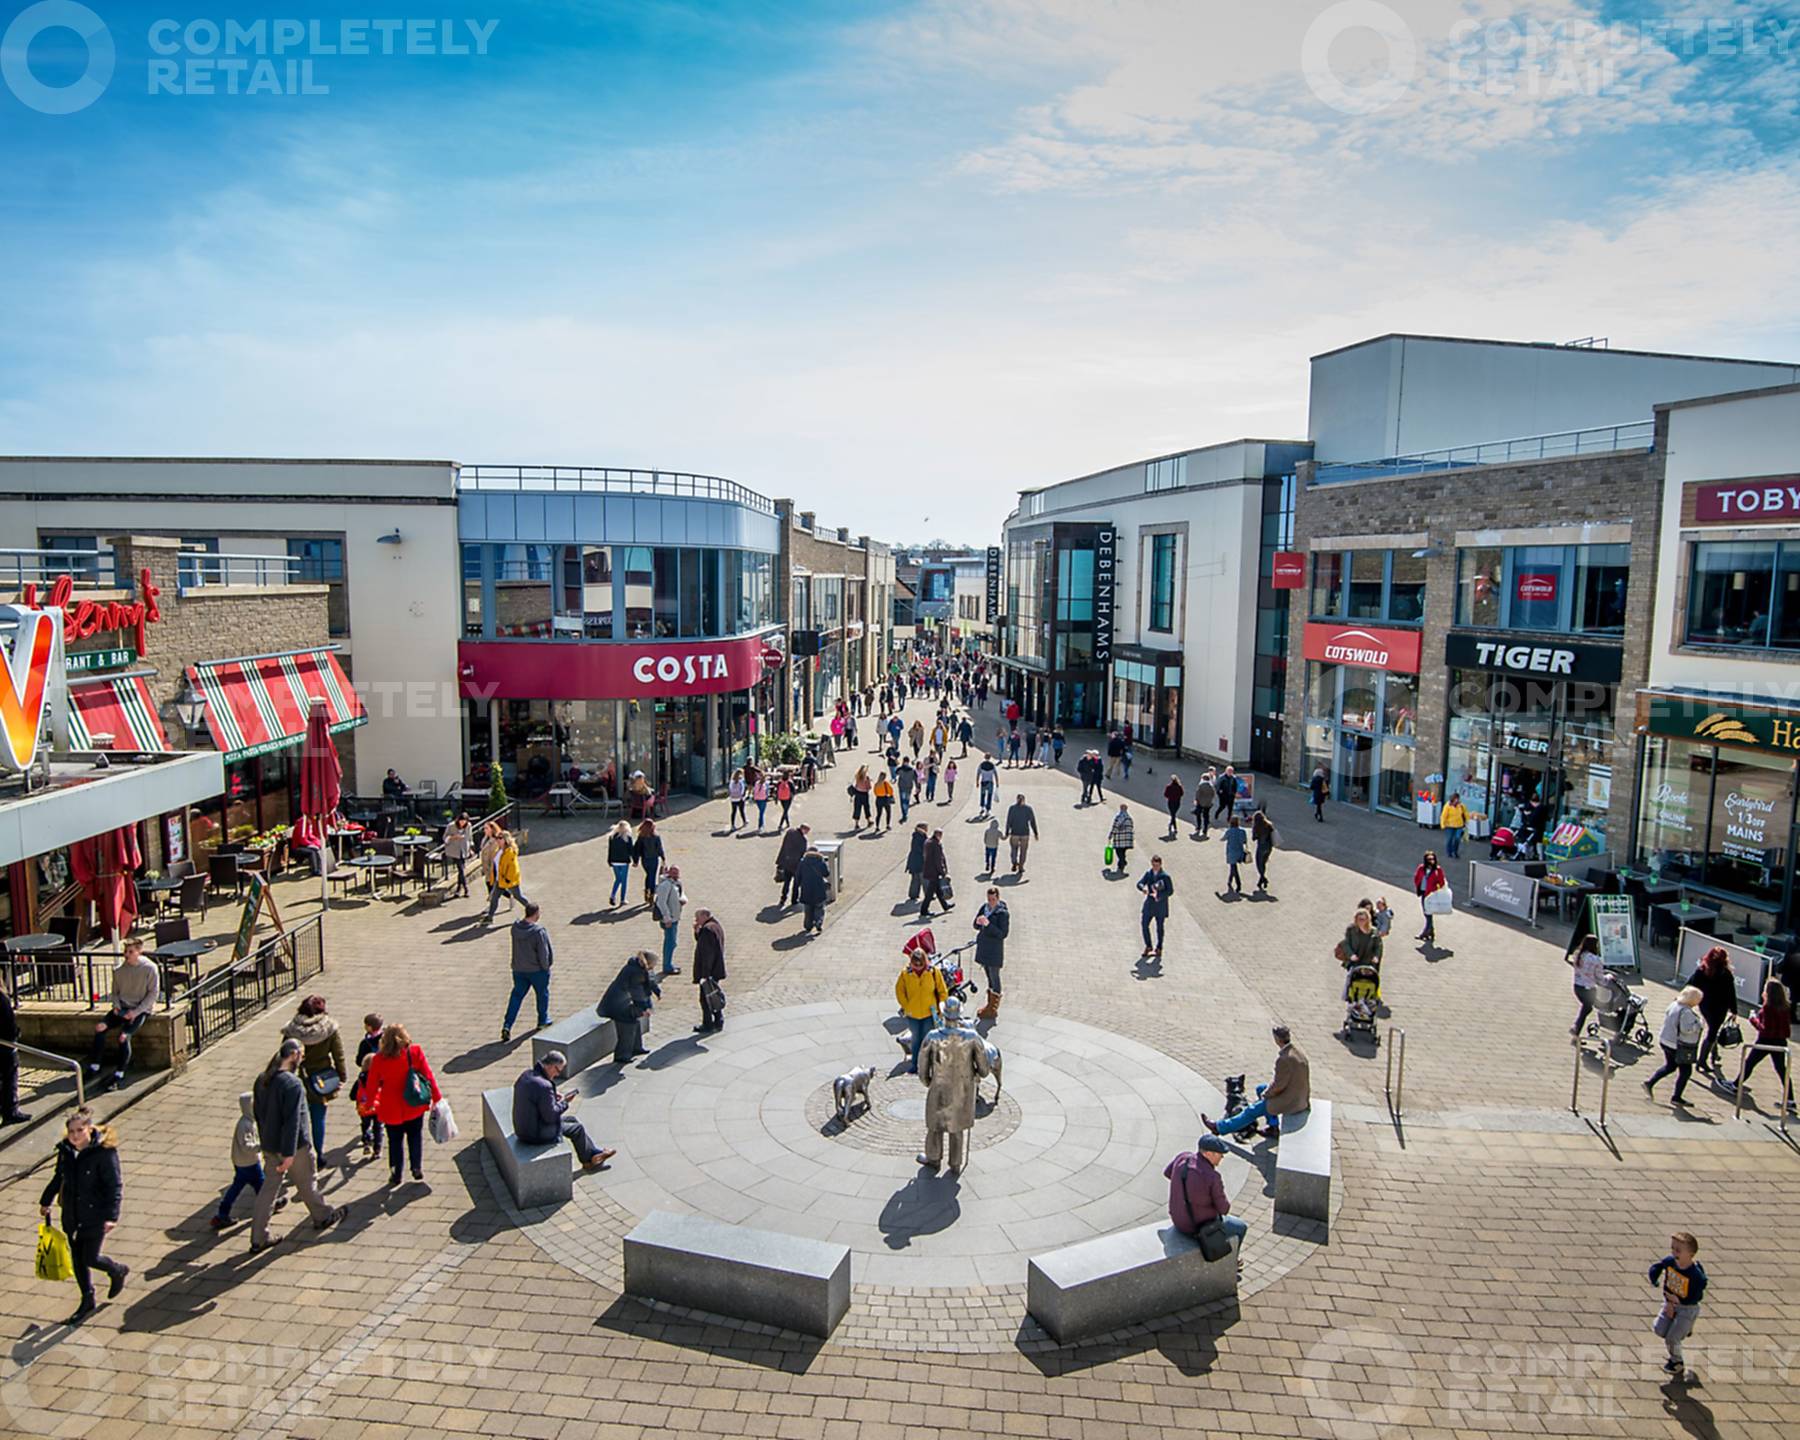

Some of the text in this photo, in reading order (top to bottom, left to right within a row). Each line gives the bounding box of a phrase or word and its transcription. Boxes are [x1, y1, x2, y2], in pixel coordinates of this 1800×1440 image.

[1716, 487, 1800, 512] TOBY
[1096, 532, 1112, 660] DEBENHAMS
[98, 654, 104, 666] &
[111, 651, 129, 665] BAR
[1325, 645, 1388, 665] COTSWOLD
[1476, 643, 1575, 674] TIGER
[633, 654, 729, 684] COSTA
[1504, 736, 1548, 752] TIGER
[1727, 824, 1764, 842] MAINS
